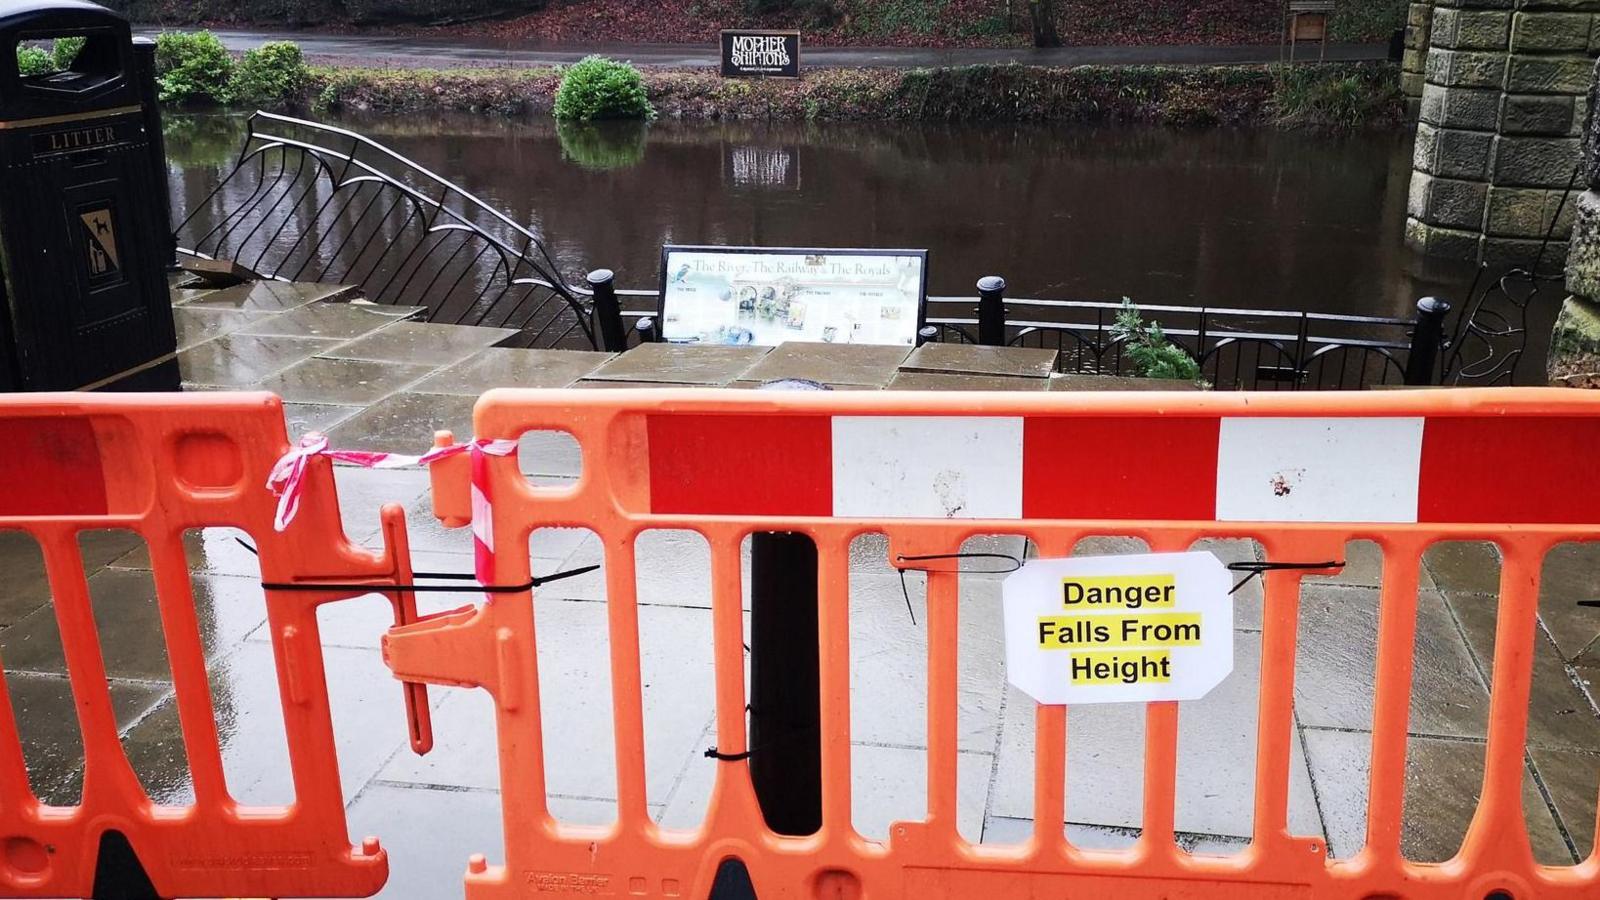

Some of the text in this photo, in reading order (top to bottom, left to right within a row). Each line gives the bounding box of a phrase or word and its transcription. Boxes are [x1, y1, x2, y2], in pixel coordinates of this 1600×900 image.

[732, 36, 787, 53] MOTHER
[52, 127, 115, 149] LITTER
[693, 259, 715, 272] The
[754, 261, 775, 274] The
[777, 262, 818, 277] Railway
[830, 263, 852, 275] The
[856, 264, 890, 278] Royals
[1063, 582, 1175, 608] Danger
[1039, 619, 1201, 644] Falls From
[1071, 656, 1171, 684] Height
